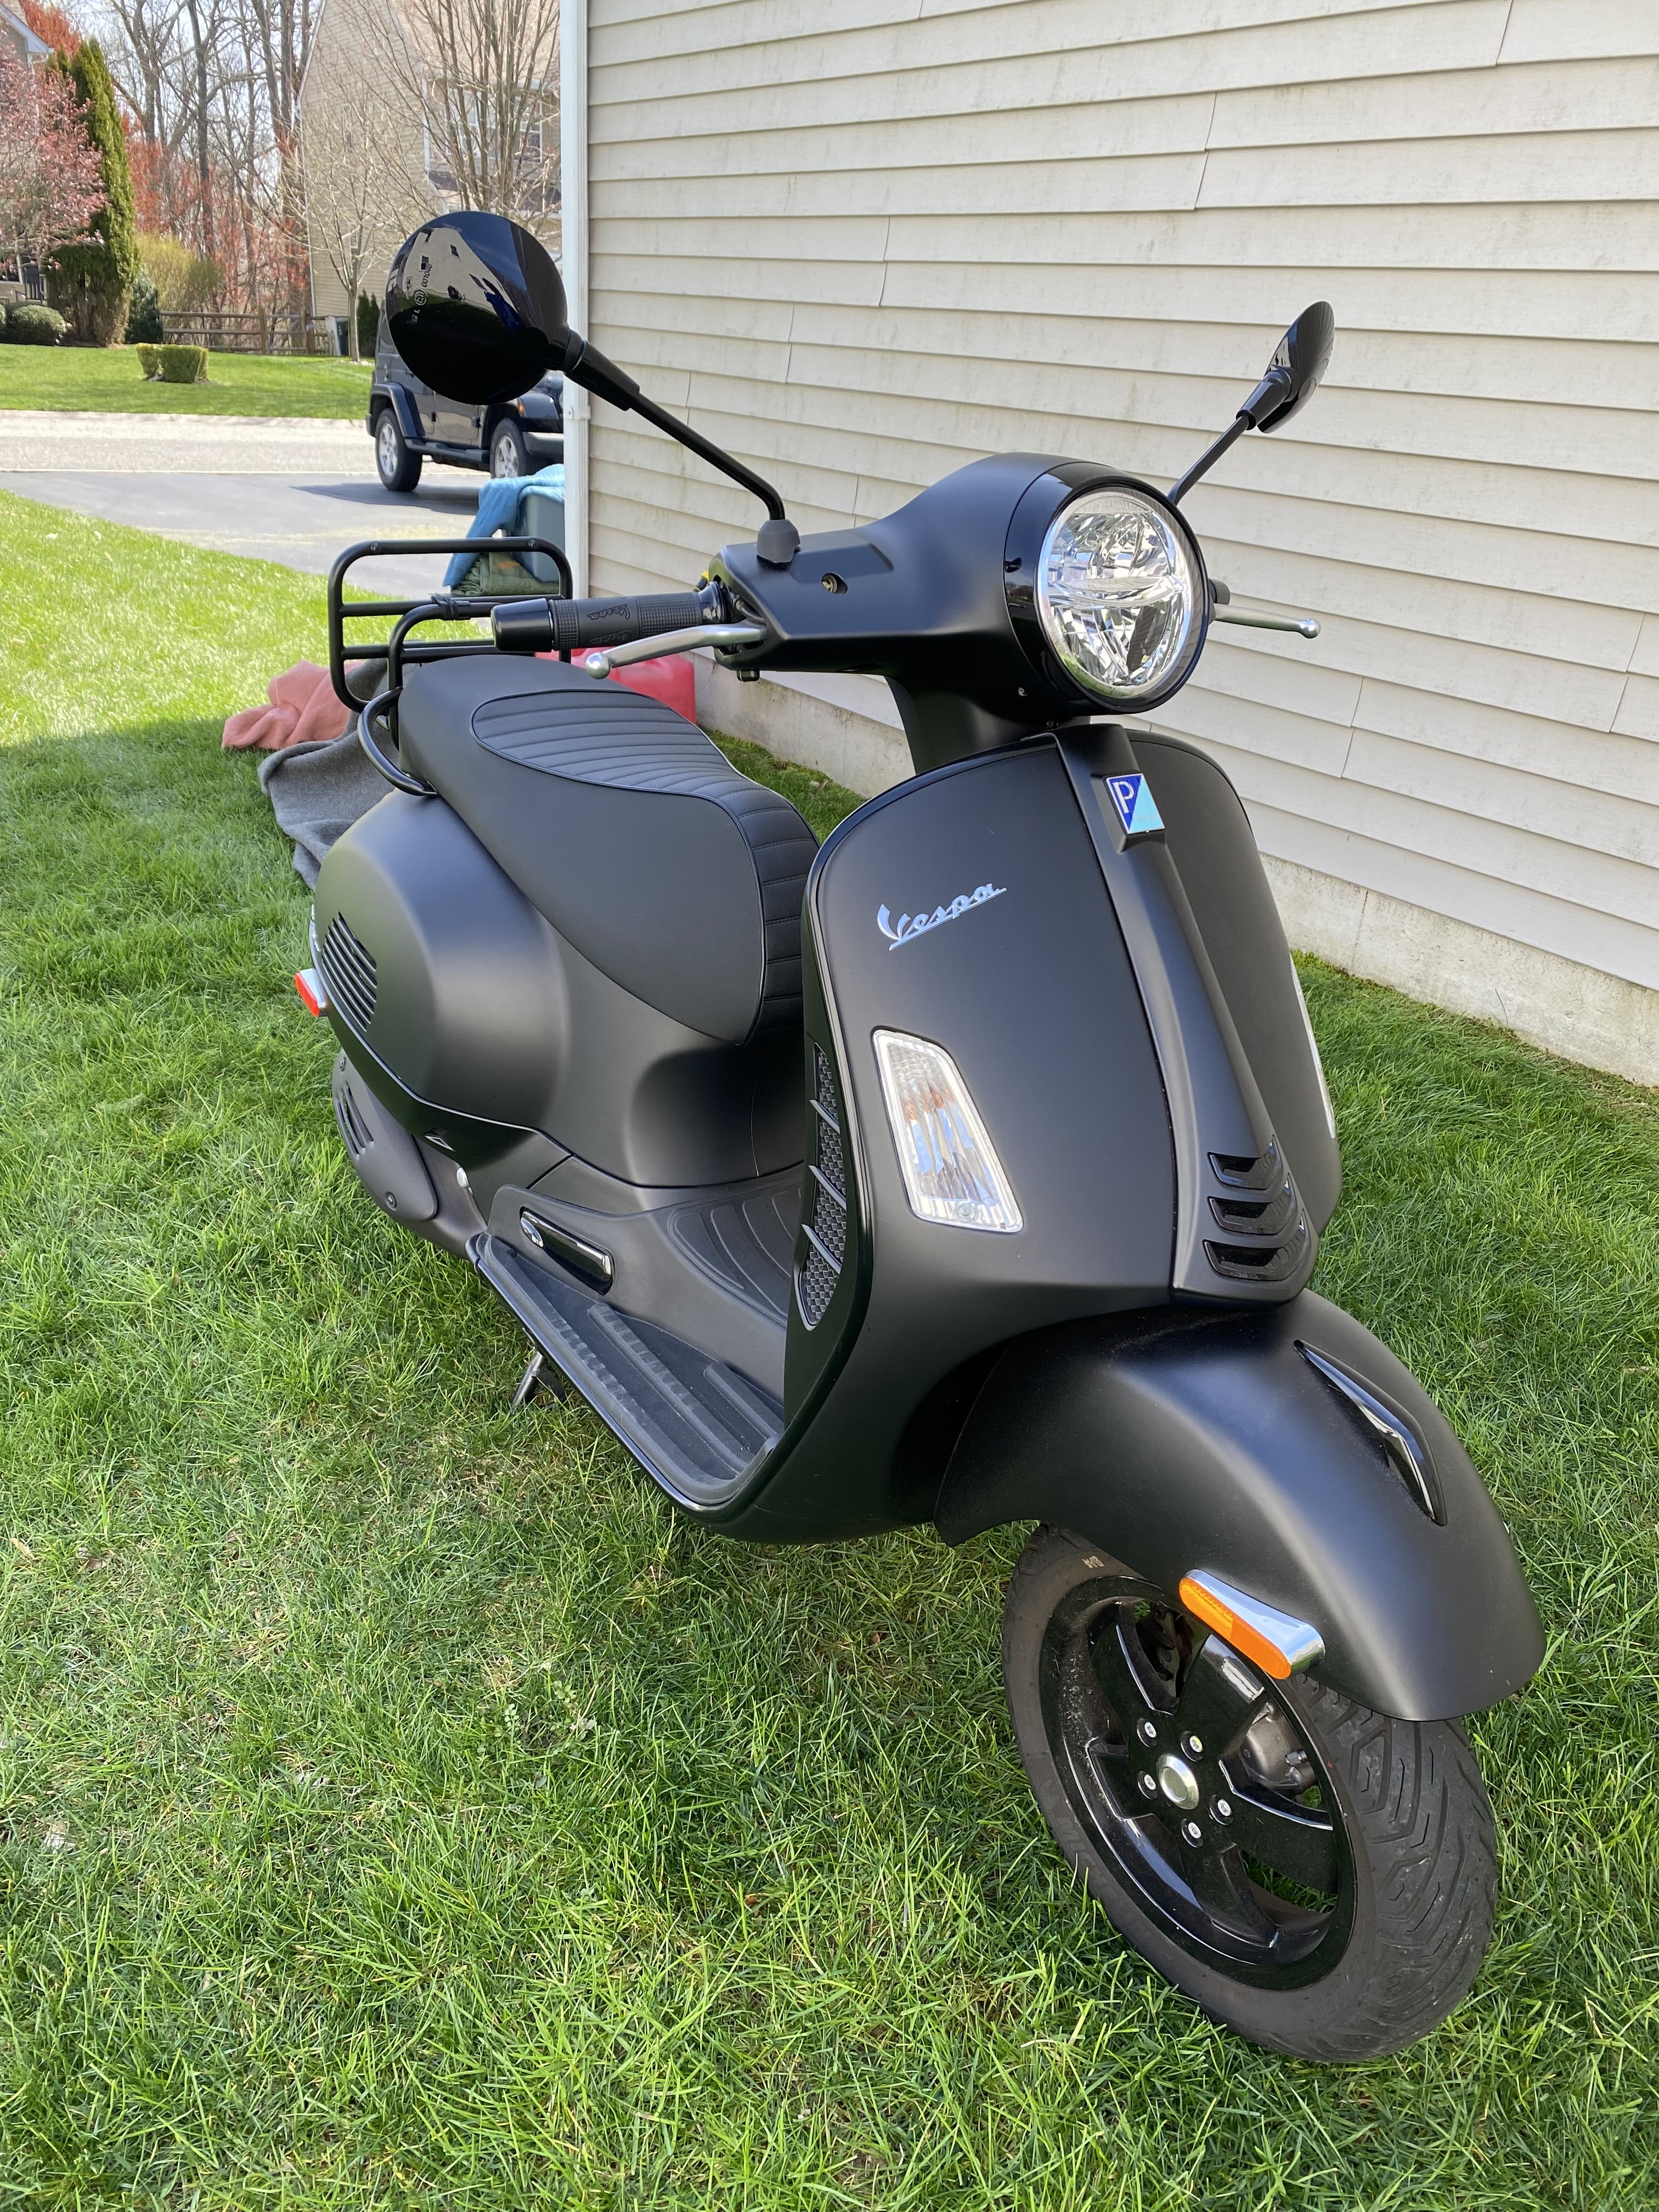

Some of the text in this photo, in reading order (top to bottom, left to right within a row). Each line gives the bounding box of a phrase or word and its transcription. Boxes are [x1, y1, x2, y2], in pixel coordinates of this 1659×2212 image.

[587, 603, 630, 620] Vespa
[1111, 781, 1135, 814] P
[877, 883, 1007, 951] Vespa
